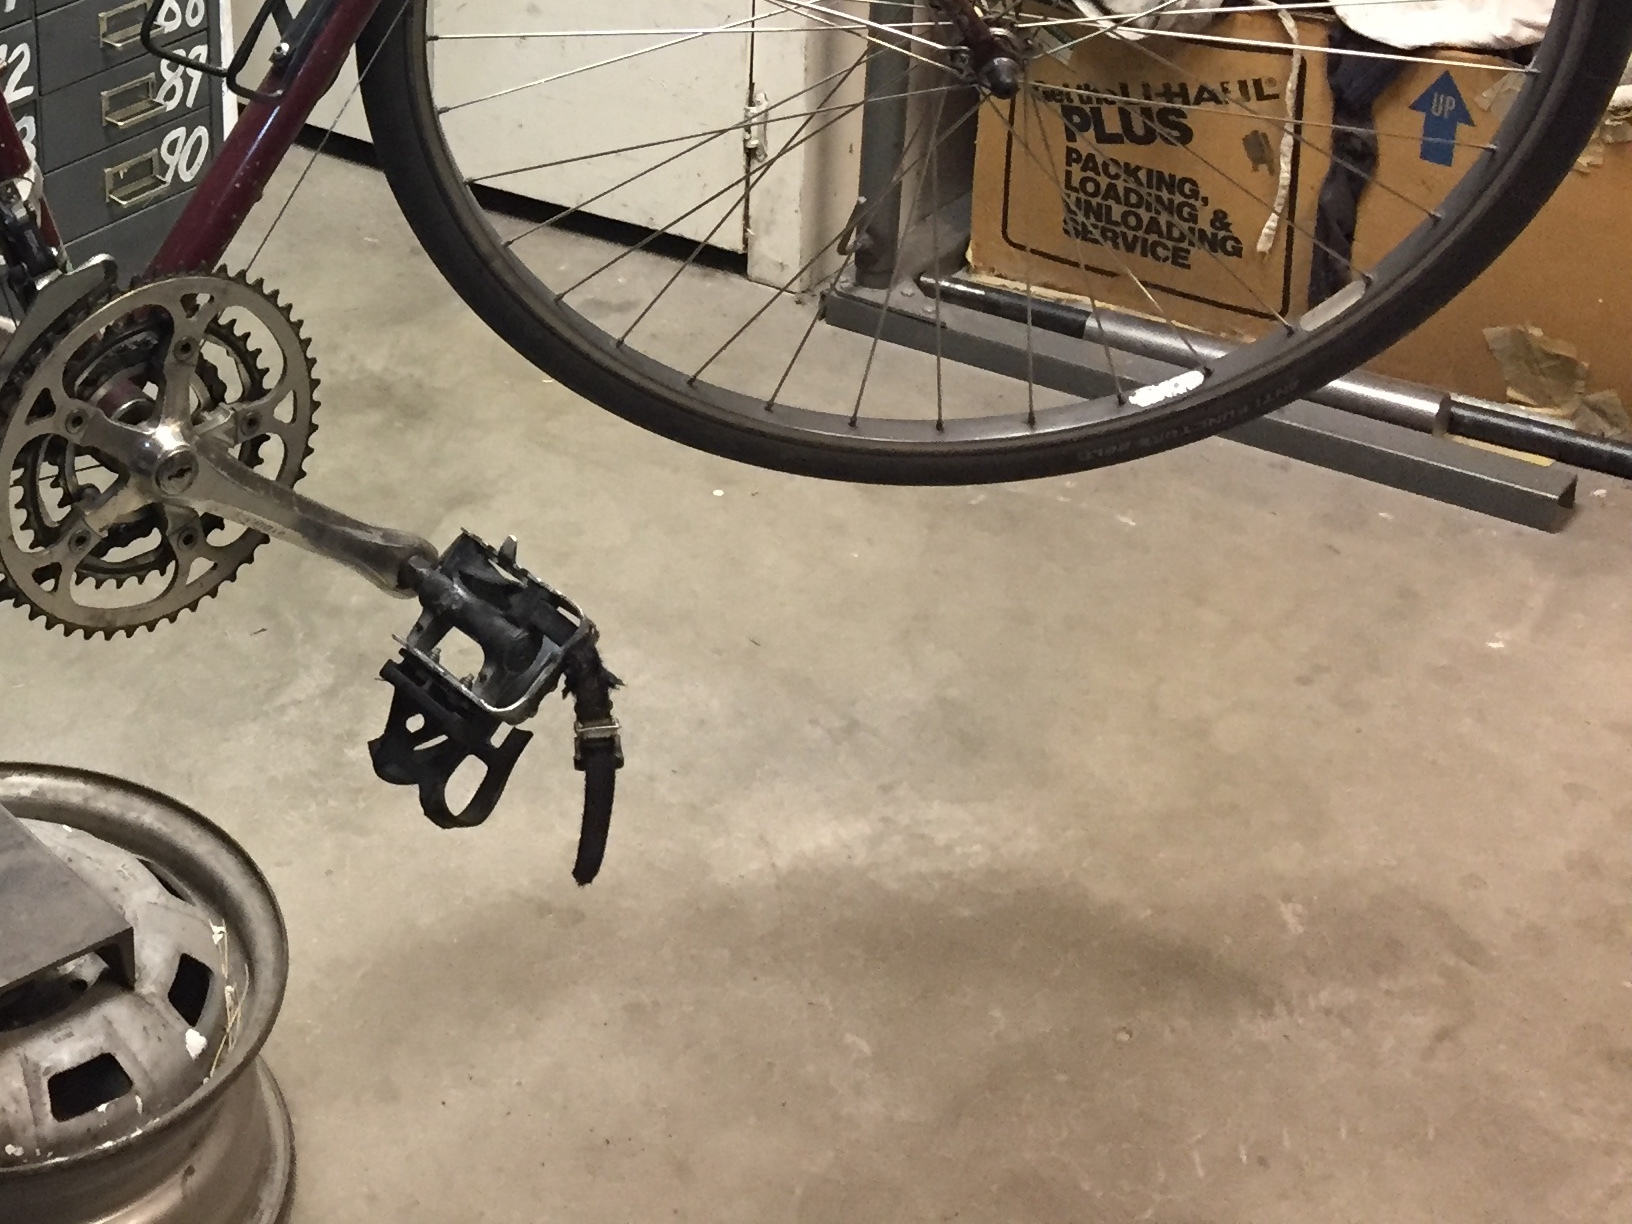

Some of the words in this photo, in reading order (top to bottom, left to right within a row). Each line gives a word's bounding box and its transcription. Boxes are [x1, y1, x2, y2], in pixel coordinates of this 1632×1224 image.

[1060, 103, 1194, 147] PLUS
[1431, 92, 1456, 119] UP
[159, 125, 209, 184] 90
[1064, 144, 1210, 207] PACKING,
[1063, 191, 1243, 259] UNLOADING
[1064, 169, 1199, 225] LOADING
[1210, 208, 1233, 233] &
[1062, 216, 1192, 271] SERVICE
